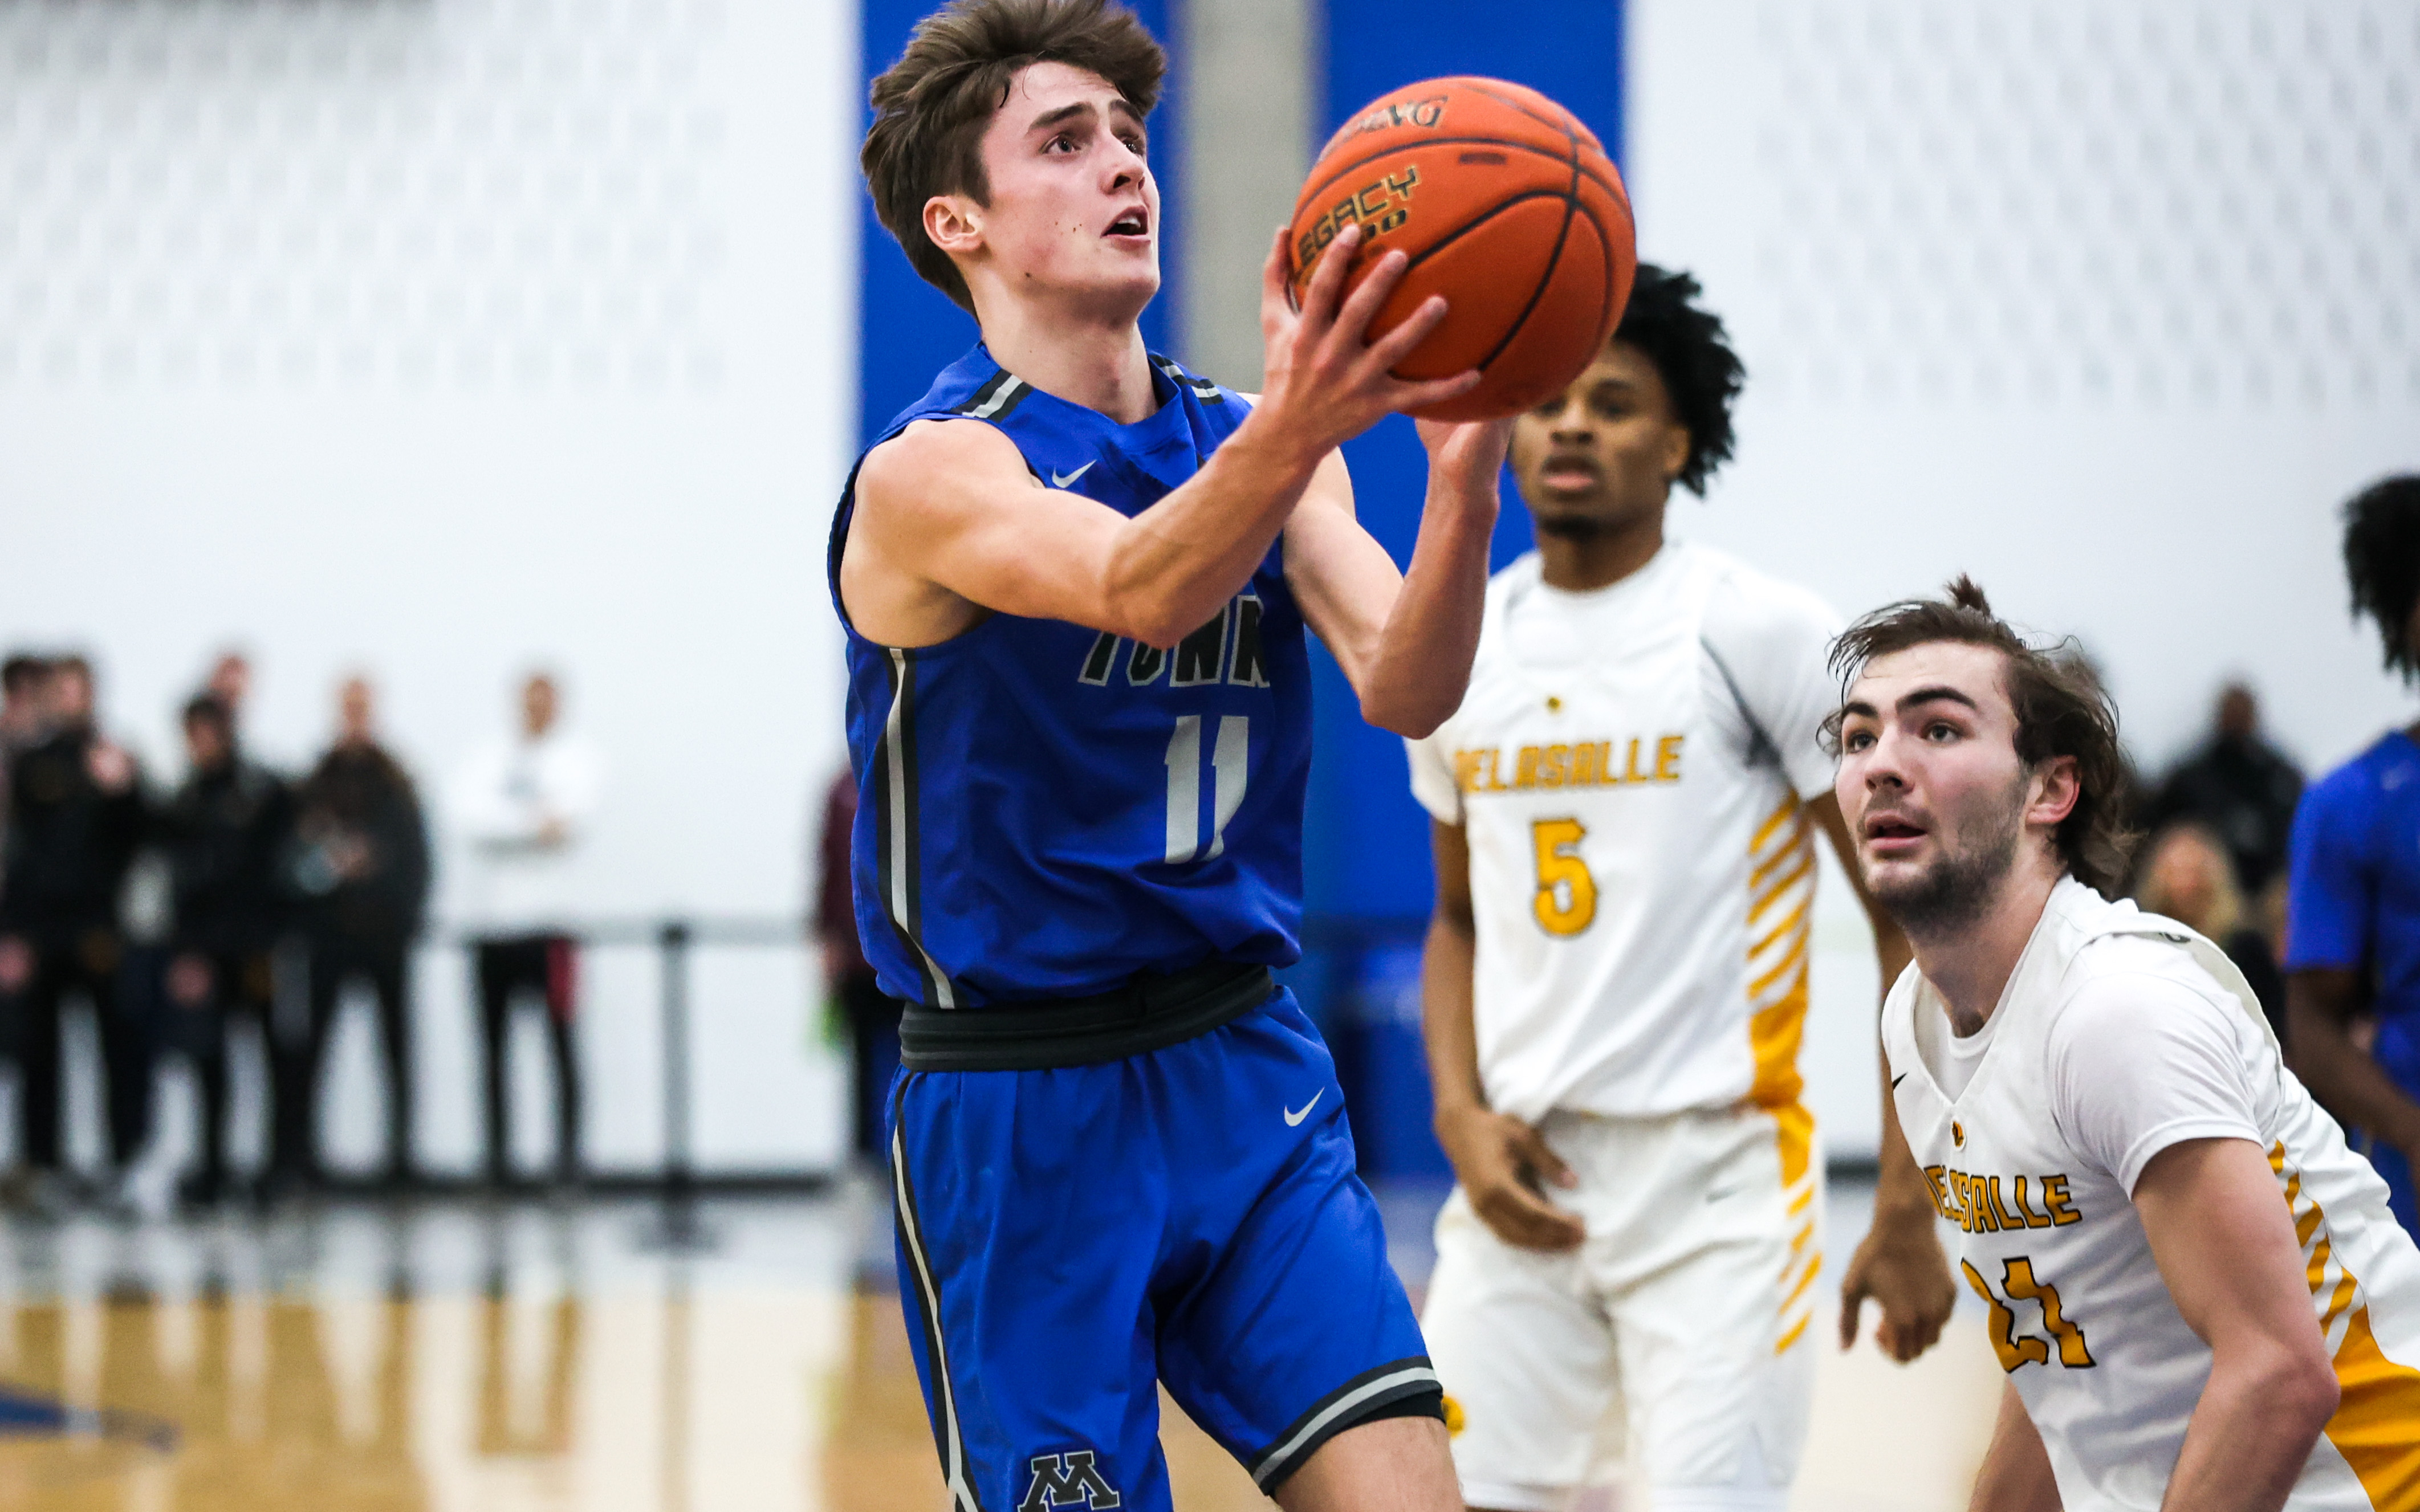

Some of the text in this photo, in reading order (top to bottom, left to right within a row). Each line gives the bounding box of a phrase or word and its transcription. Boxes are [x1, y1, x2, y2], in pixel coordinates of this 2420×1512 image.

[1296, 164, 1421, 270] EGACY
[1164, 715, 1249, 865] 11
[1532, 817, 1598, 938] 5
[1923, 1164, 2083, 1233] ELSALLE
[1961, 1256, 2096, 1374] 21
[1018, 1450, 1120, 1512] M
